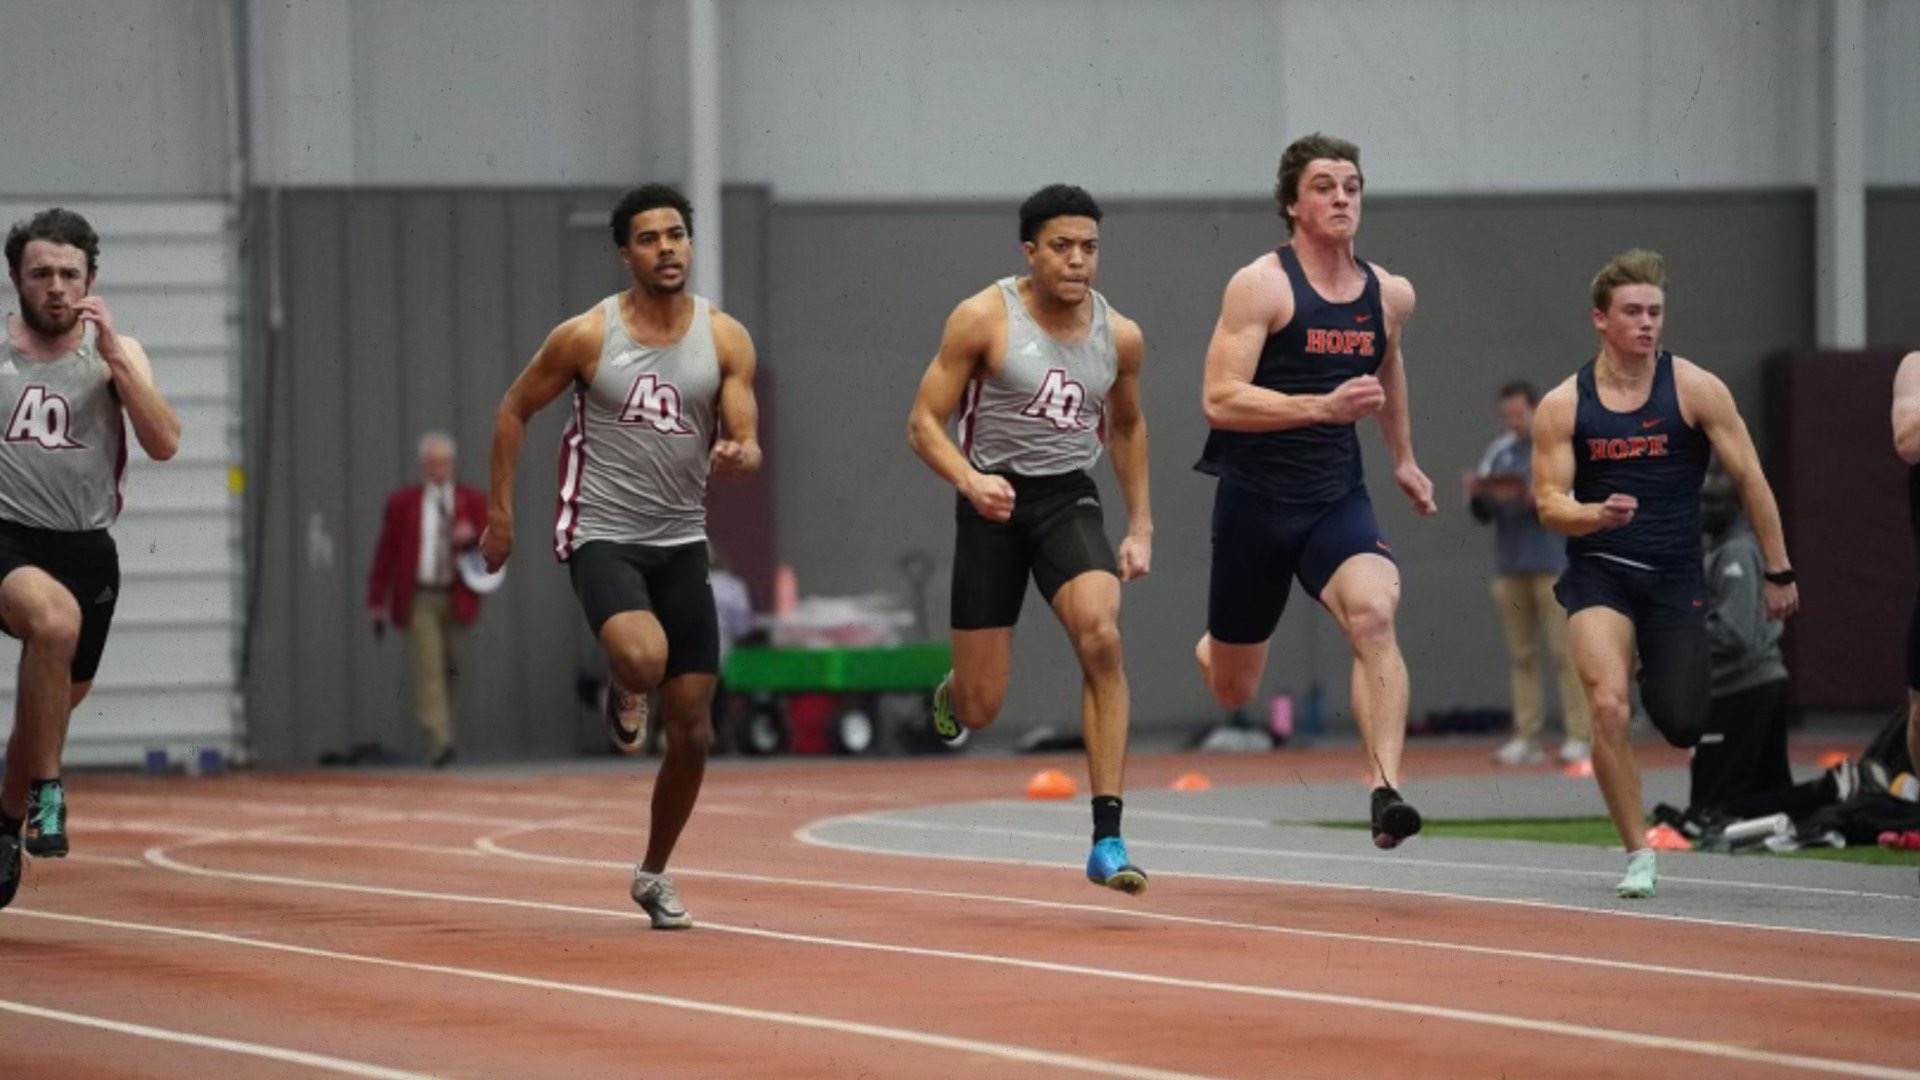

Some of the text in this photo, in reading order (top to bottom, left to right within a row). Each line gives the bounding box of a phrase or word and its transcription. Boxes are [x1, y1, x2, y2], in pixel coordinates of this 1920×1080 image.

[1305, 328, 1375, 355] HOPE
[4, 386, 88, 449] AQ
[618, 374, 696, 434] AQ
[1020, 369, 1090, 430] AQ
[1587, 434, 1669, 461] HOPE
